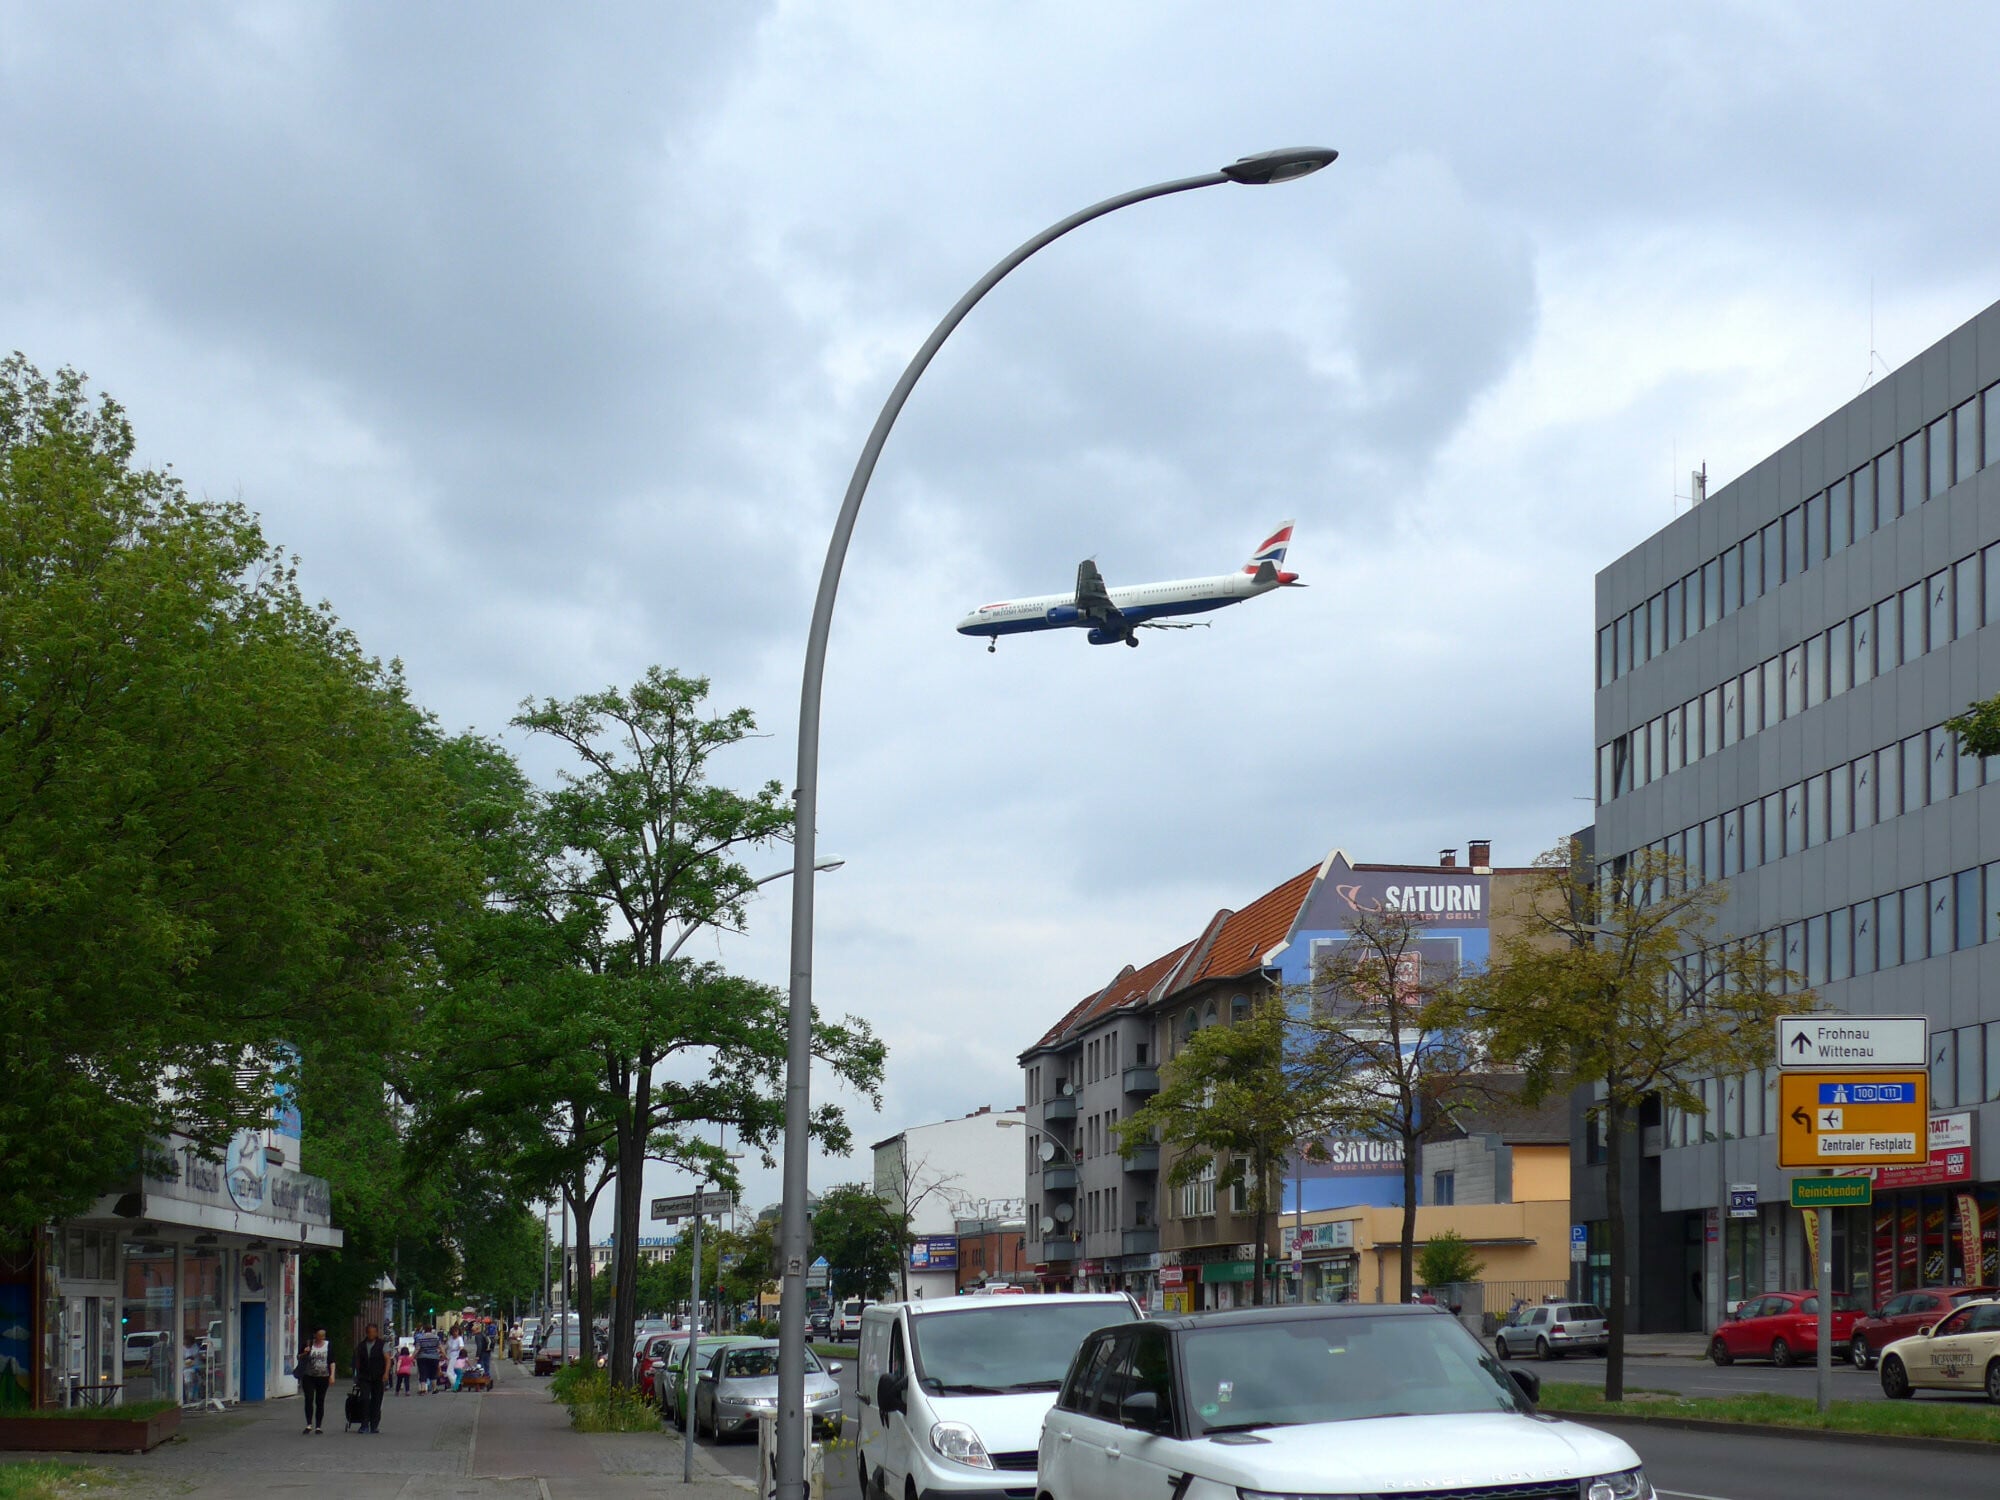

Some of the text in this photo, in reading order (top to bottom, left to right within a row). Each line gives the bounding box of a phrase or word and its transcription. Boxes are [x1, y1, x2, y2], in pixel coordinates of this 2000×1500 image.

[1386, 885, 1480, 912] SATURN
[1818, 1027, 1870, 1040] Frohnau
[1818, 1046, 1874, 1057] Wittenau
[1858, 1087, 1896, 1098] 100 111
[1333, 1140, 1406, 1163] SATURN
[1822, 1138, 1912, 1152] Zentraler Festplatz
[1798, 1184, 1865, 1198] Reinickendorf
[639, 1236, 684, 1246] BOWLING
[1573, 1227, 1582, 1241] P
[1384, 1468, 1573, 1489] RANGE ROVER
